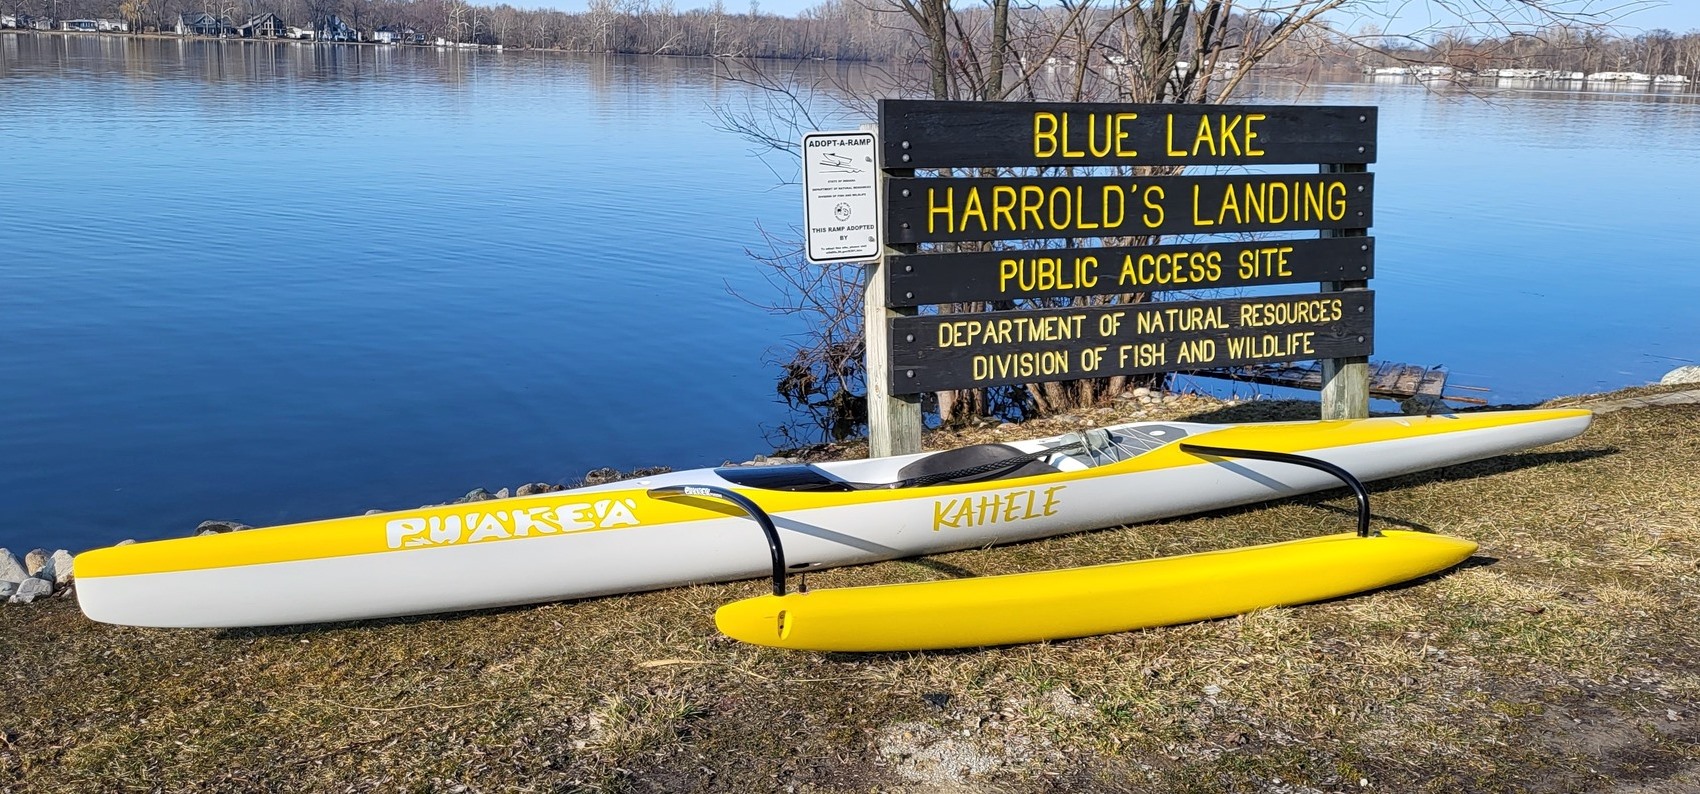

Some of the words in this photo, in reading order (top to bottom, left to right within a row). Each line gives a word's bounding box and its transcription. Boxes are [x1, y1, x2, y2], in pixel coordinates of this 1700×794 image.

[808, 138, 872, 148] ADOPT-A-RAMP
[1033, 112, 1138, 158] BLUE
[1165, 113, 1266, 158] LAKE
[928, 184, 1165, 234] HARROLD'S
[1193, 181, 1347, 227] LANDING
[1000, 255, 1099, 293] PUBLIC
[1118, 251, 1222, 286] ACCESS
[1238, 247, 1294, 281] SITE
[938, 314, 1087, 348] DEPARTMENT
[1099, 312, 1126, 338] OF
[1137, 306, 1229, 334] NATURAL
[1240, 299, 1342, 327] RESOURCES
[972, 350, 1069, 381] DIVISION
[1080, 347, 1107, 372] OF
[1119, 343, 1165, 369] FISH
[1177, 339, 1216, 365] AND
[1228, 332, 1315, 360] WILDLIFE
[933, 485, 1067, 532] KAHELE
